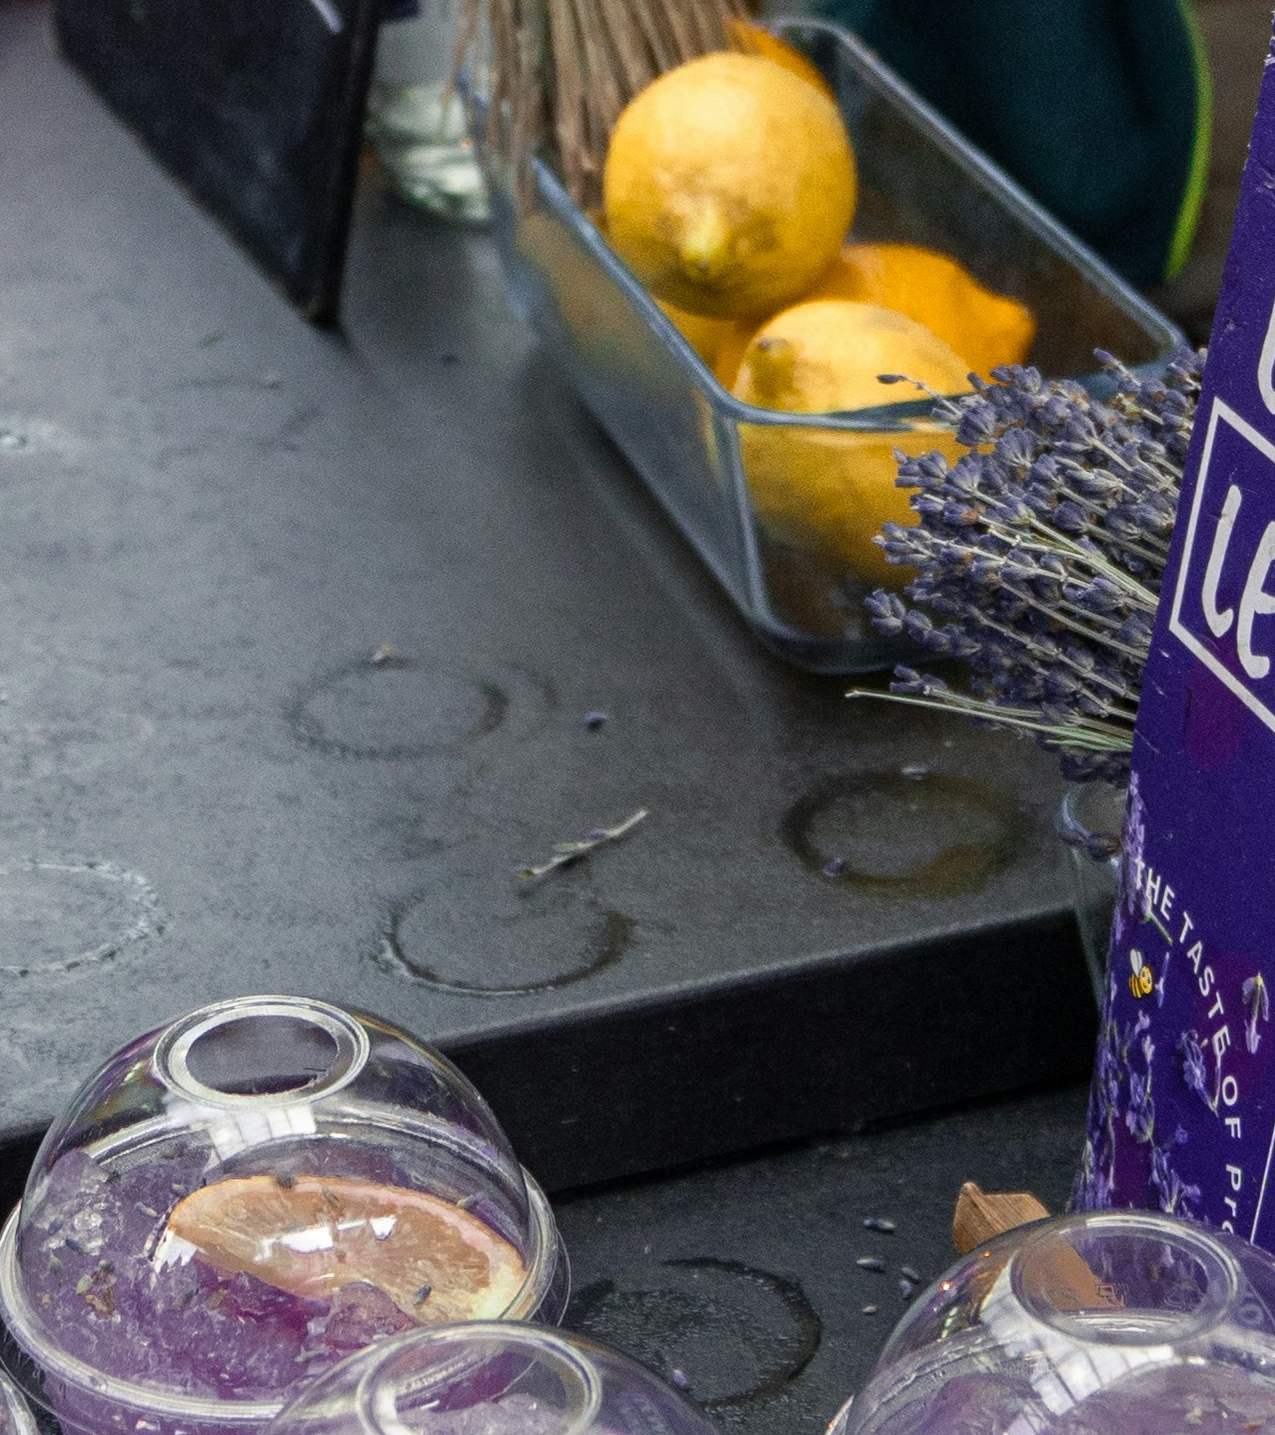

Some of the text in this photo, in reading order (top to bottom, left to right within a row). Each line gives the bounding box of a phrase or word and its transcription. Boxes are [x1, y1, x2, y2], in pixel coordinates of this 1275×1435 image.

[1133, 854, 1176, 922] THE
[1179, 910, 1232, 1058] TASTE
[1221, 1074, 1242, 1140] OF
